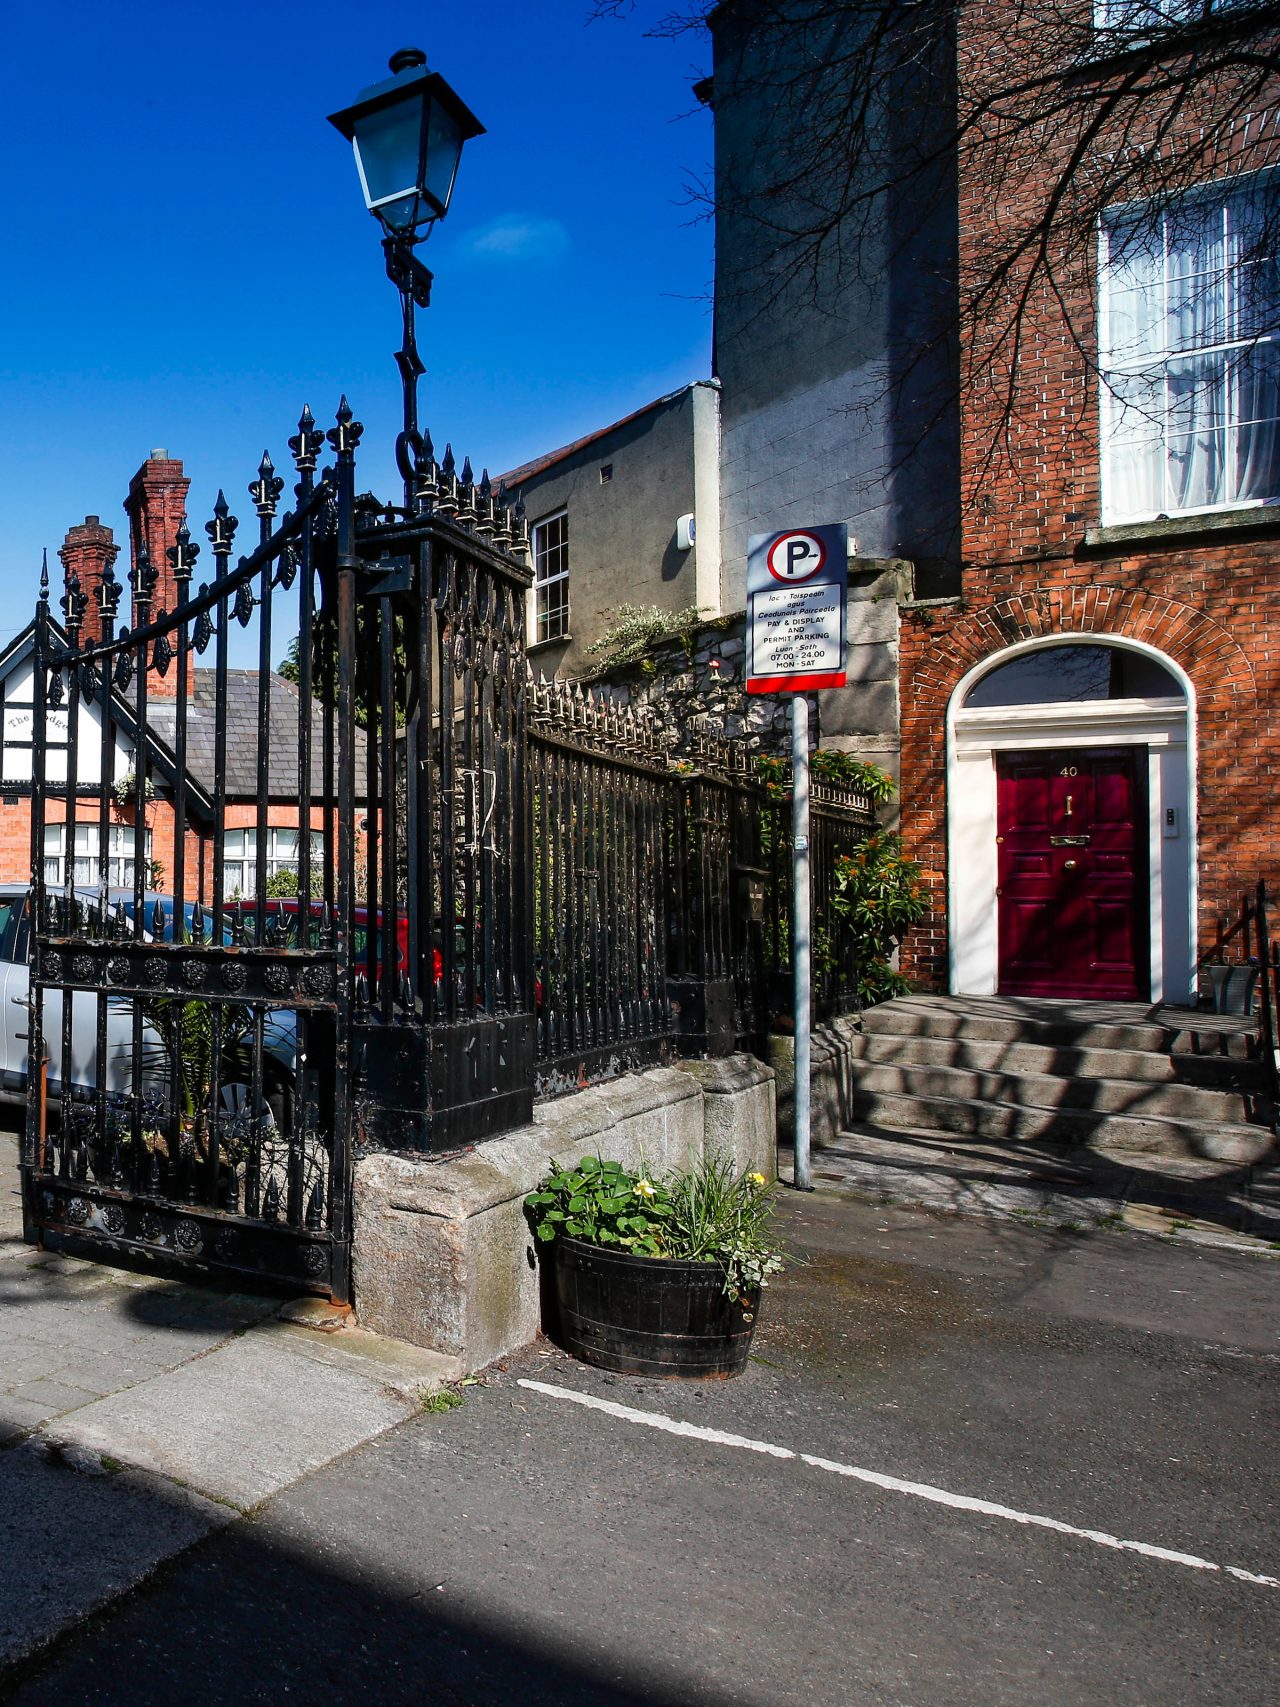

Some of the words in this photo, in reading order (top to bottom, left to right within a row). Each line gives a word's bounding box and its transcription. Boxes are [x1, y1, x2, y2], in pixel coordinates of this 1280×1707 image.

[787, 540, 810, 575] P
[792, 617, 825, 625] DISPLAY
[794, 632, 830, 641] PARKING
[770, 653, 794, 661] 07.00
[8, 715, 29, 728] The
[1060, 766, 1077, 778] 40
